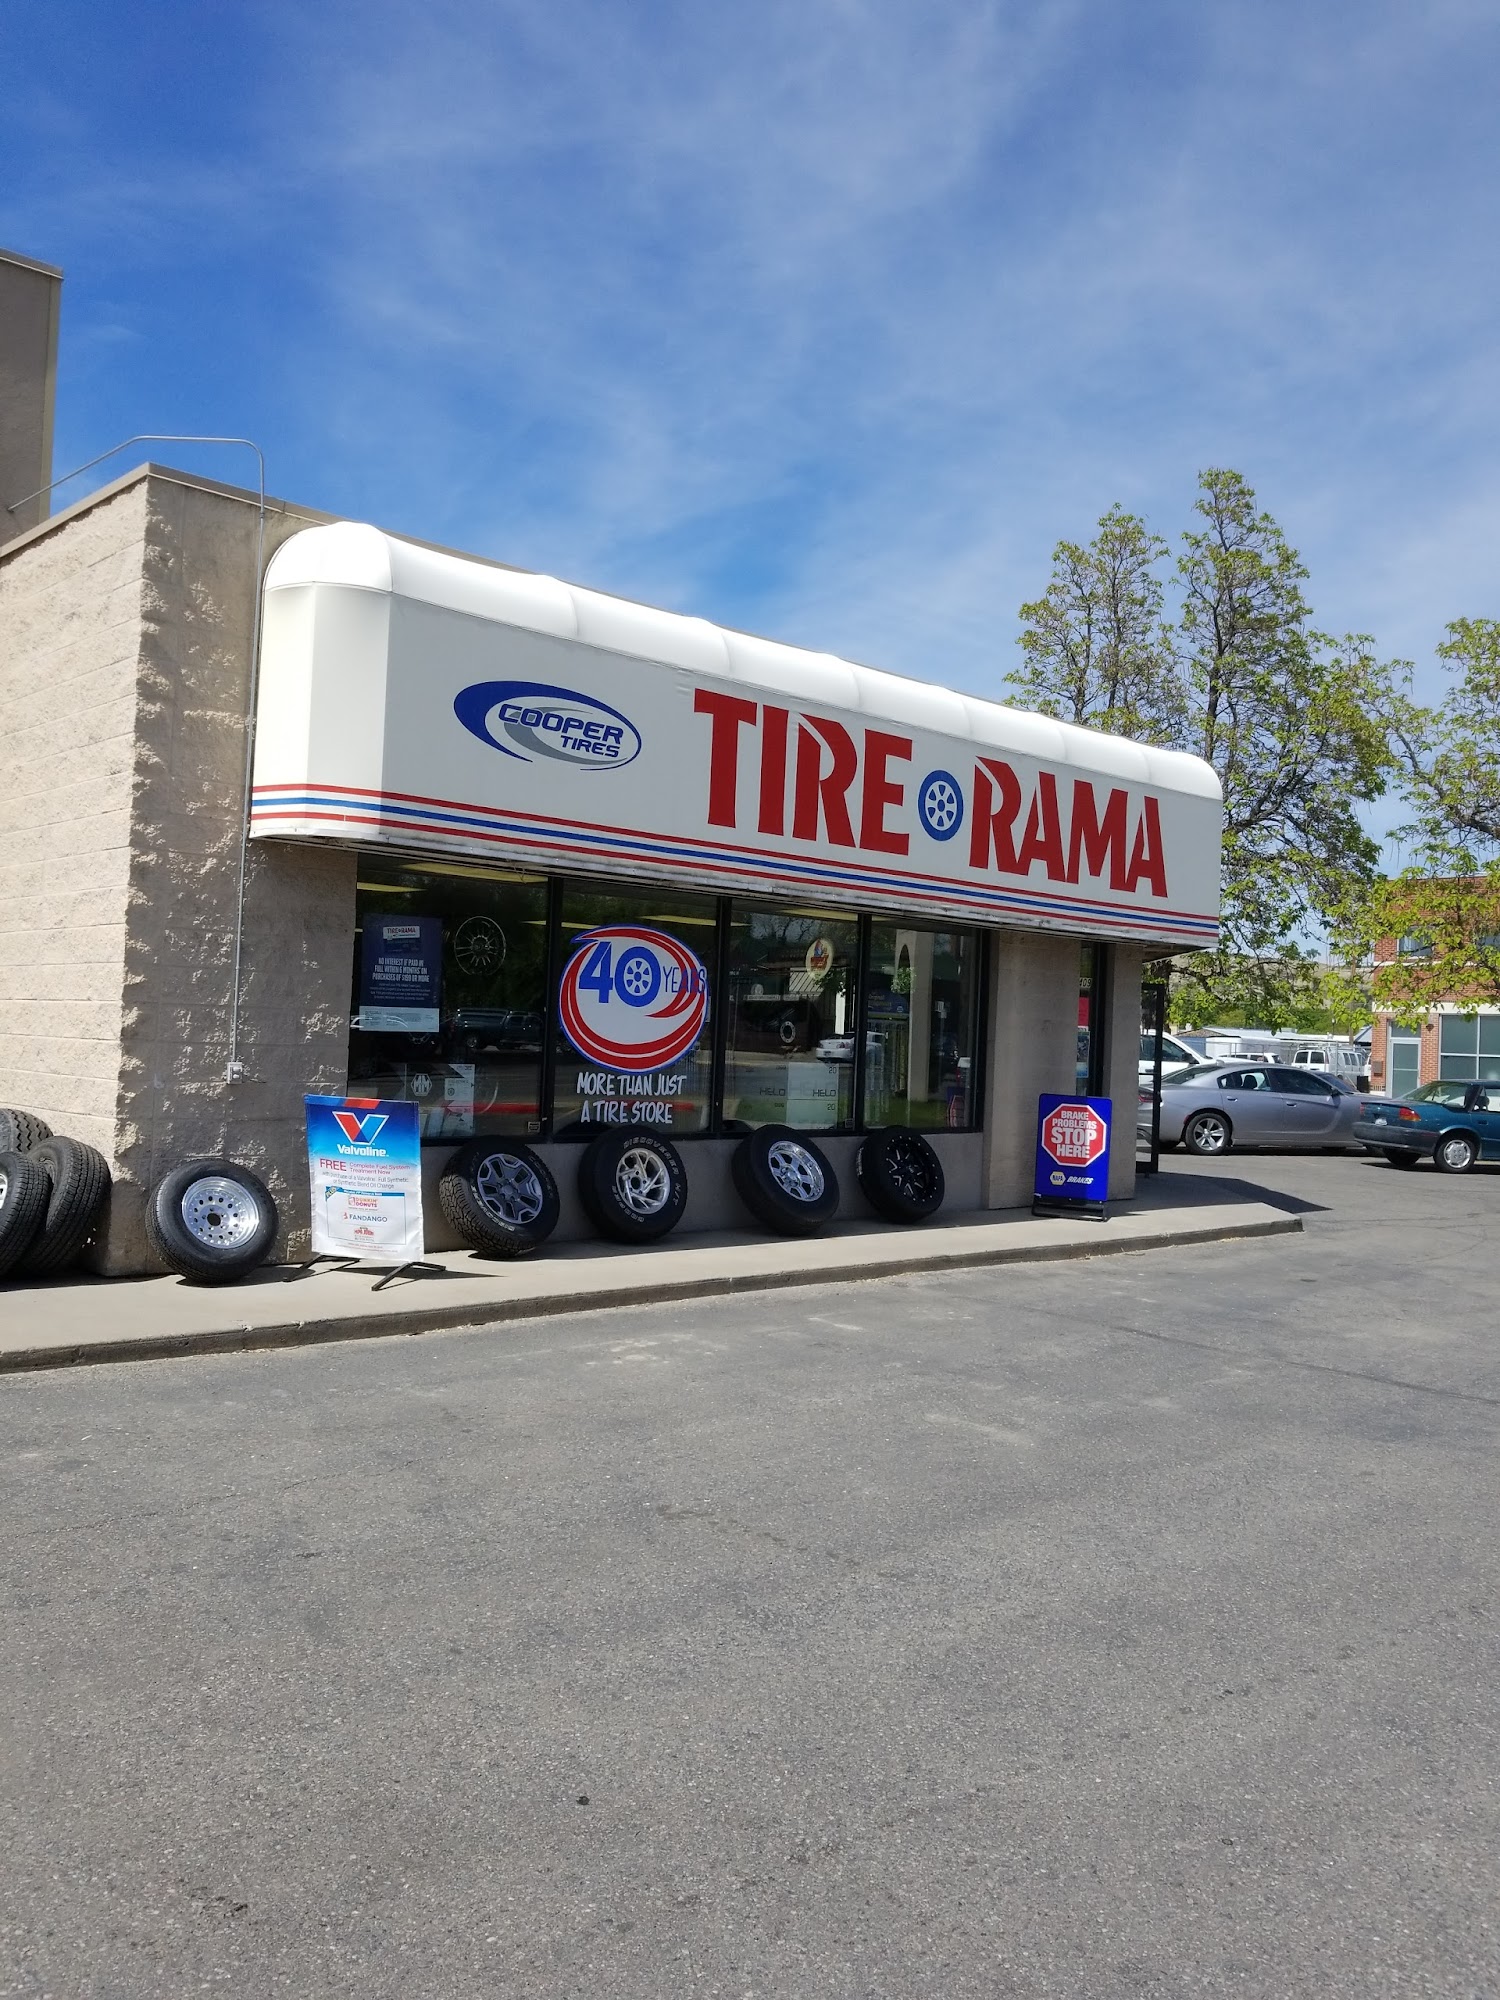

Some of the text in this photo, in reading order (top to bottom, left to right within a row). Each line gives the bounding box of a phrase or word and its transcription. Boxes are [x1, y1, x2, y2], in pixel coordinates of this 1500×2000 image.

[498, 704, 624, 744] COOPER
[561, 735, 620, 757] TIRES
[694, 688, 1168, 898] TIRE RAMA
[385, 958, 403, 966] INTEREST
[372, 973, 395, 981] PURCHASES
[578, 941, 705, 1007] 40 YEARS
[577, 1072, 687, 1096] MORE THAN JUST
[581, 1100, 673, 1124] A TIRE STORE
[1061, 1110, 1089, 1120] BRAKE
[1052, 1118, 1097, 1130] PROBLEMS
[1050, 1127, 1097, 1146] STOP
[337, 1144, 387, 1157] Valvoline
[1056, 1144, 1090, 1158] HERE
[320, 1158, 347, 1172] FREE
[1067, 1176, 1094, 1184] BRAKES
[349, 1214, 388, 1222] FANDANGO
